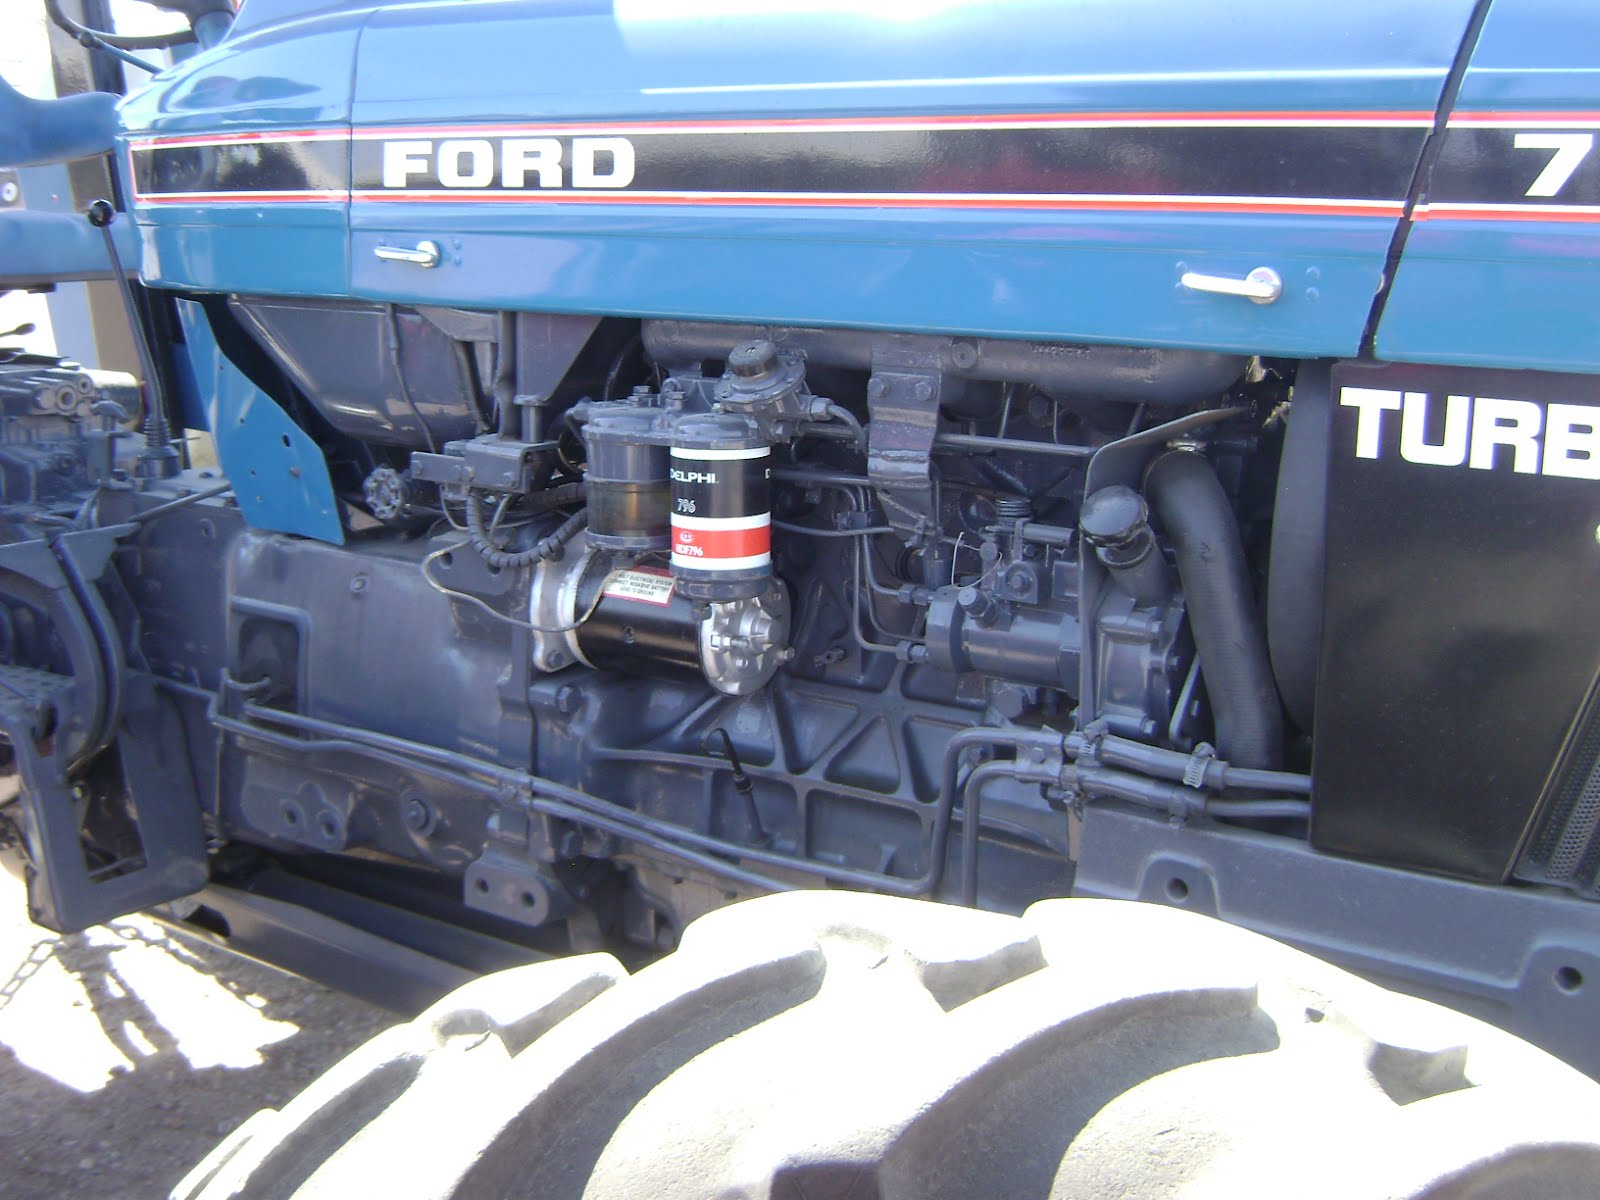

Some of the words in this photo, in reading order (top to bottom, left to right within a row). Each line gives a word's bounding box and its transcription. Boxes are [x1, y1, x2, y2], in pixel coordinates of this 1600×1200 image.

[383, 137, 635, 188] FORD
[1513, 133, 1593, 197] 7
[1340, 386, 1600, 480] TURB
[670, 468, 716, 484] DELPHI
[677, 498, 696, 513] 796
[629, 575, 655, 584] ELECTRICAL
[637, 588, 655, 596] GROUND
[651, 584, 671, 592] BATTERY
